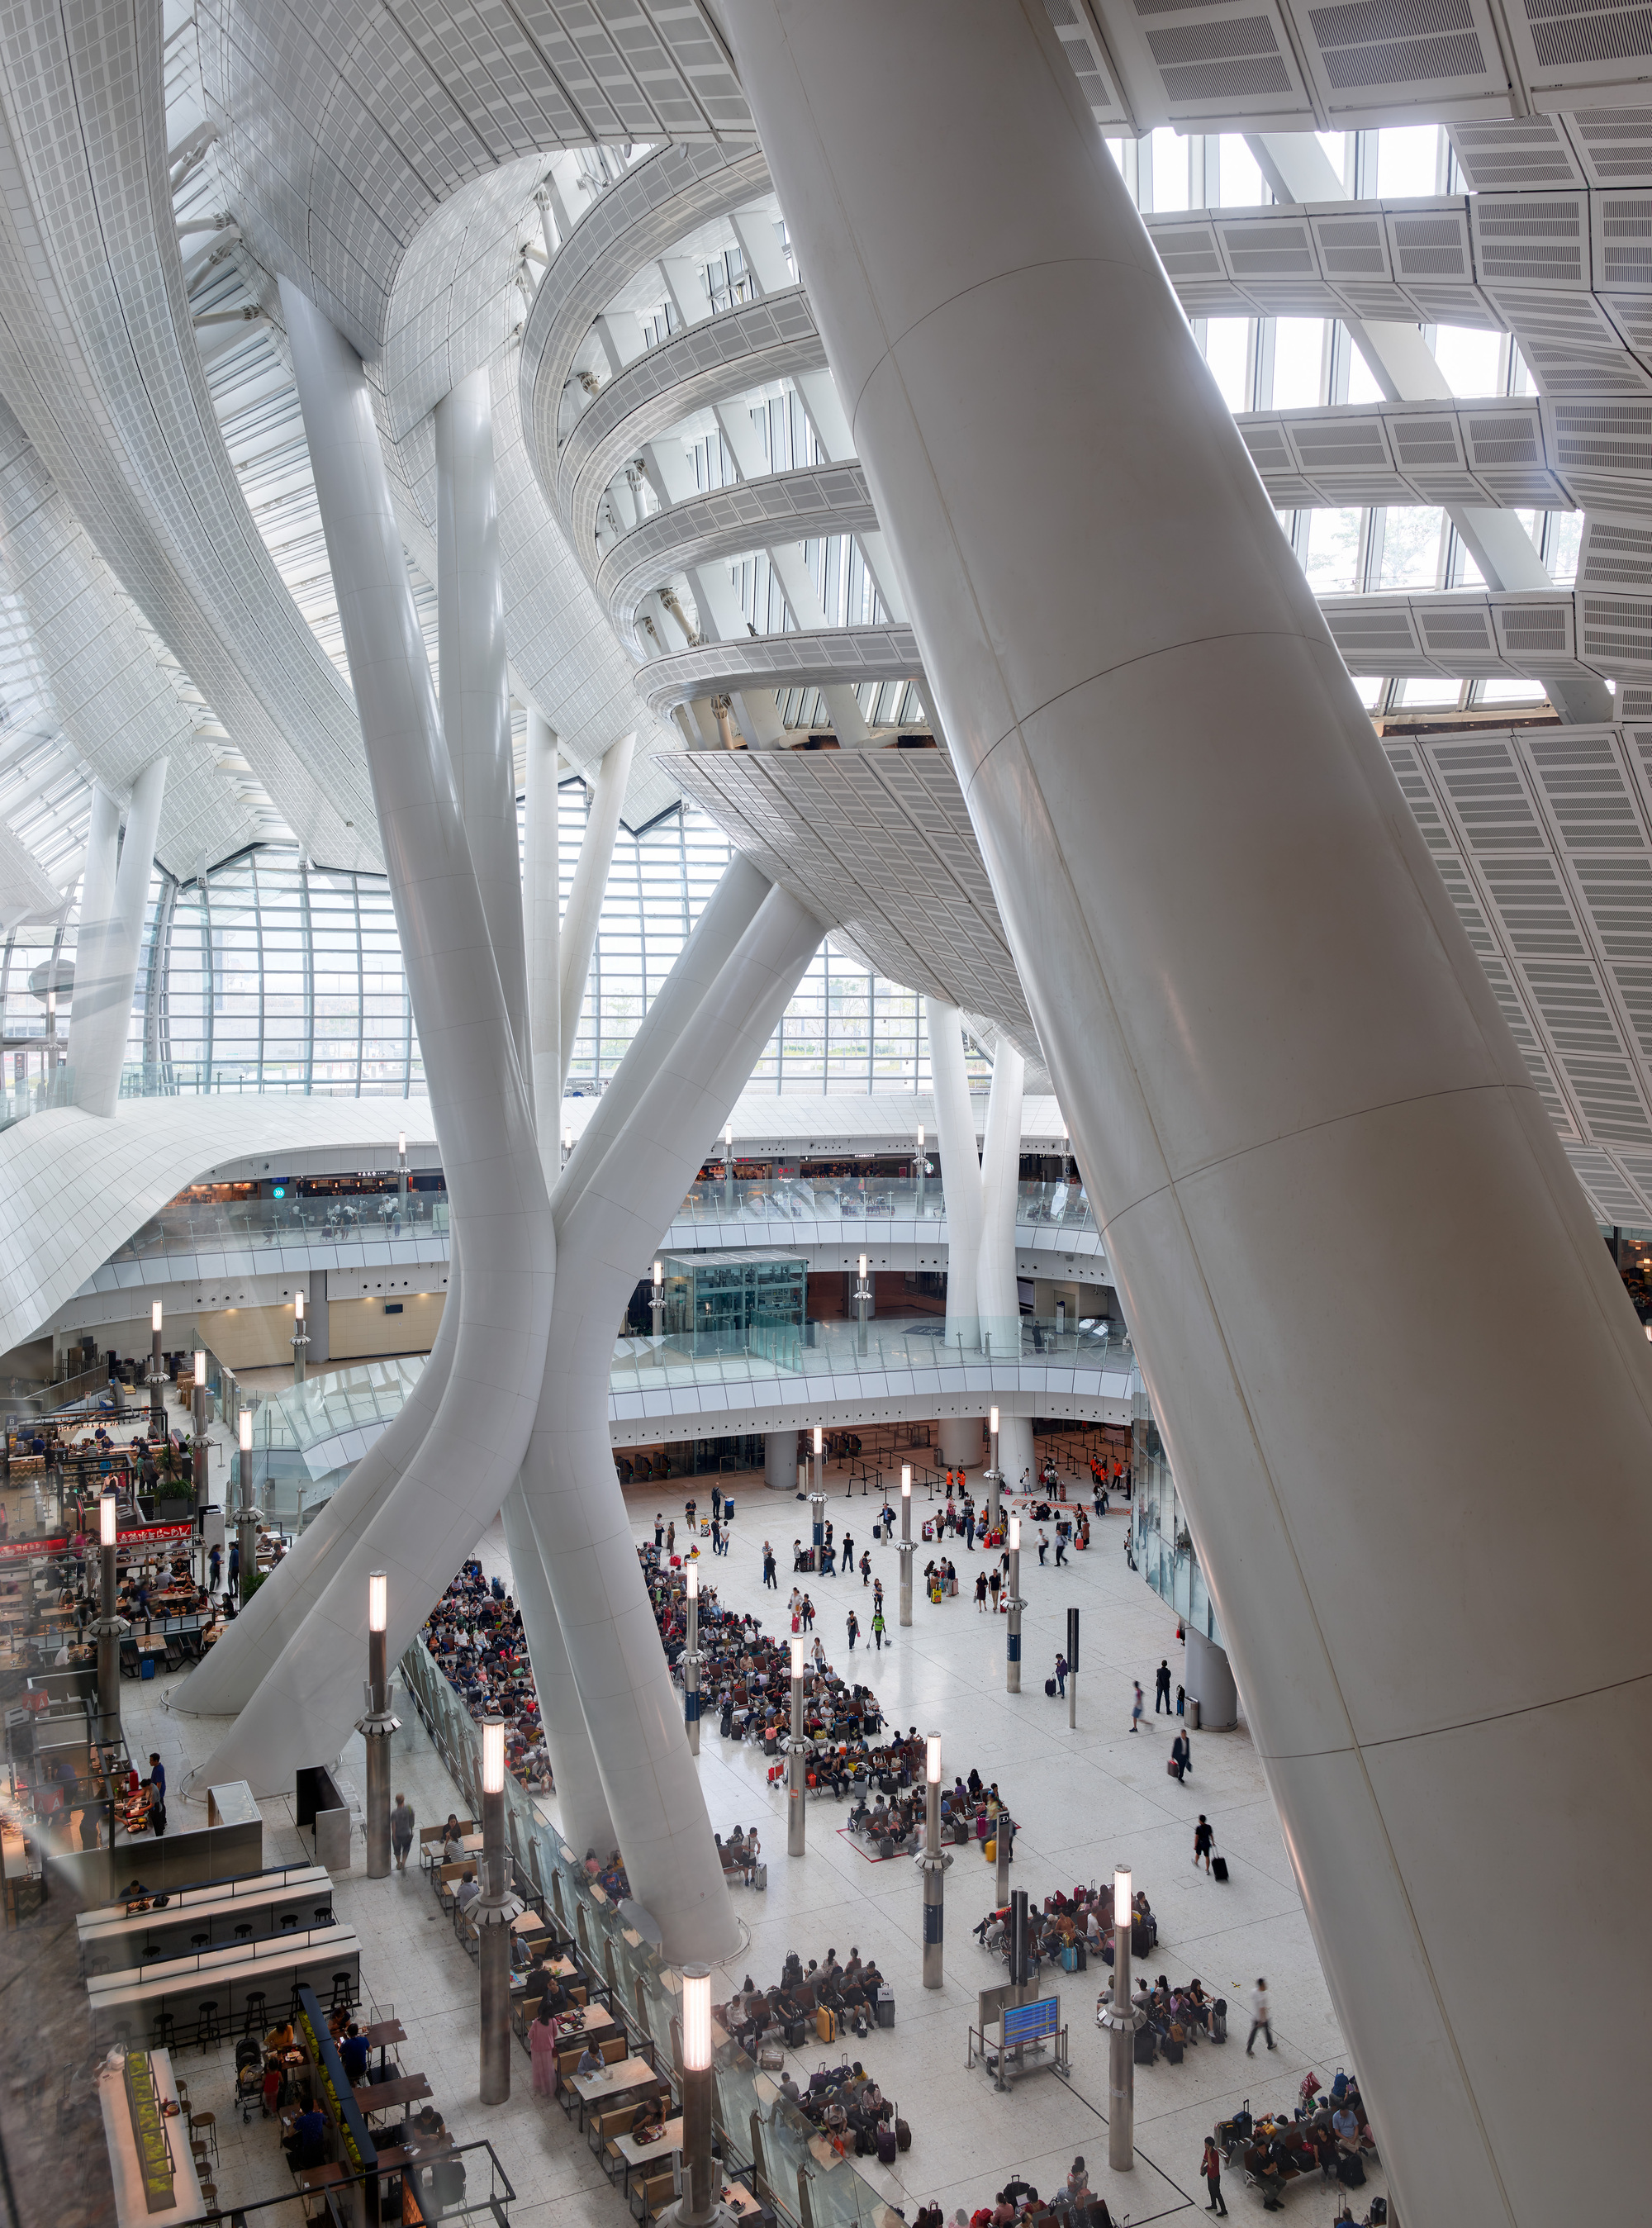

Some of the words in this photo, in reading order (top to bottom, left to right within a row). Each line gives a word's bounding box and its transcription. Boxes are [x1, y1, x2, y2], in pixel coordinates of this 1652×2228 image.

[26, 1699, 32, 1709] A
[39, 1698, 45, 1708] A
[37, 1800, 45, 1812] A
[52, 1797, 60, 1811] A
